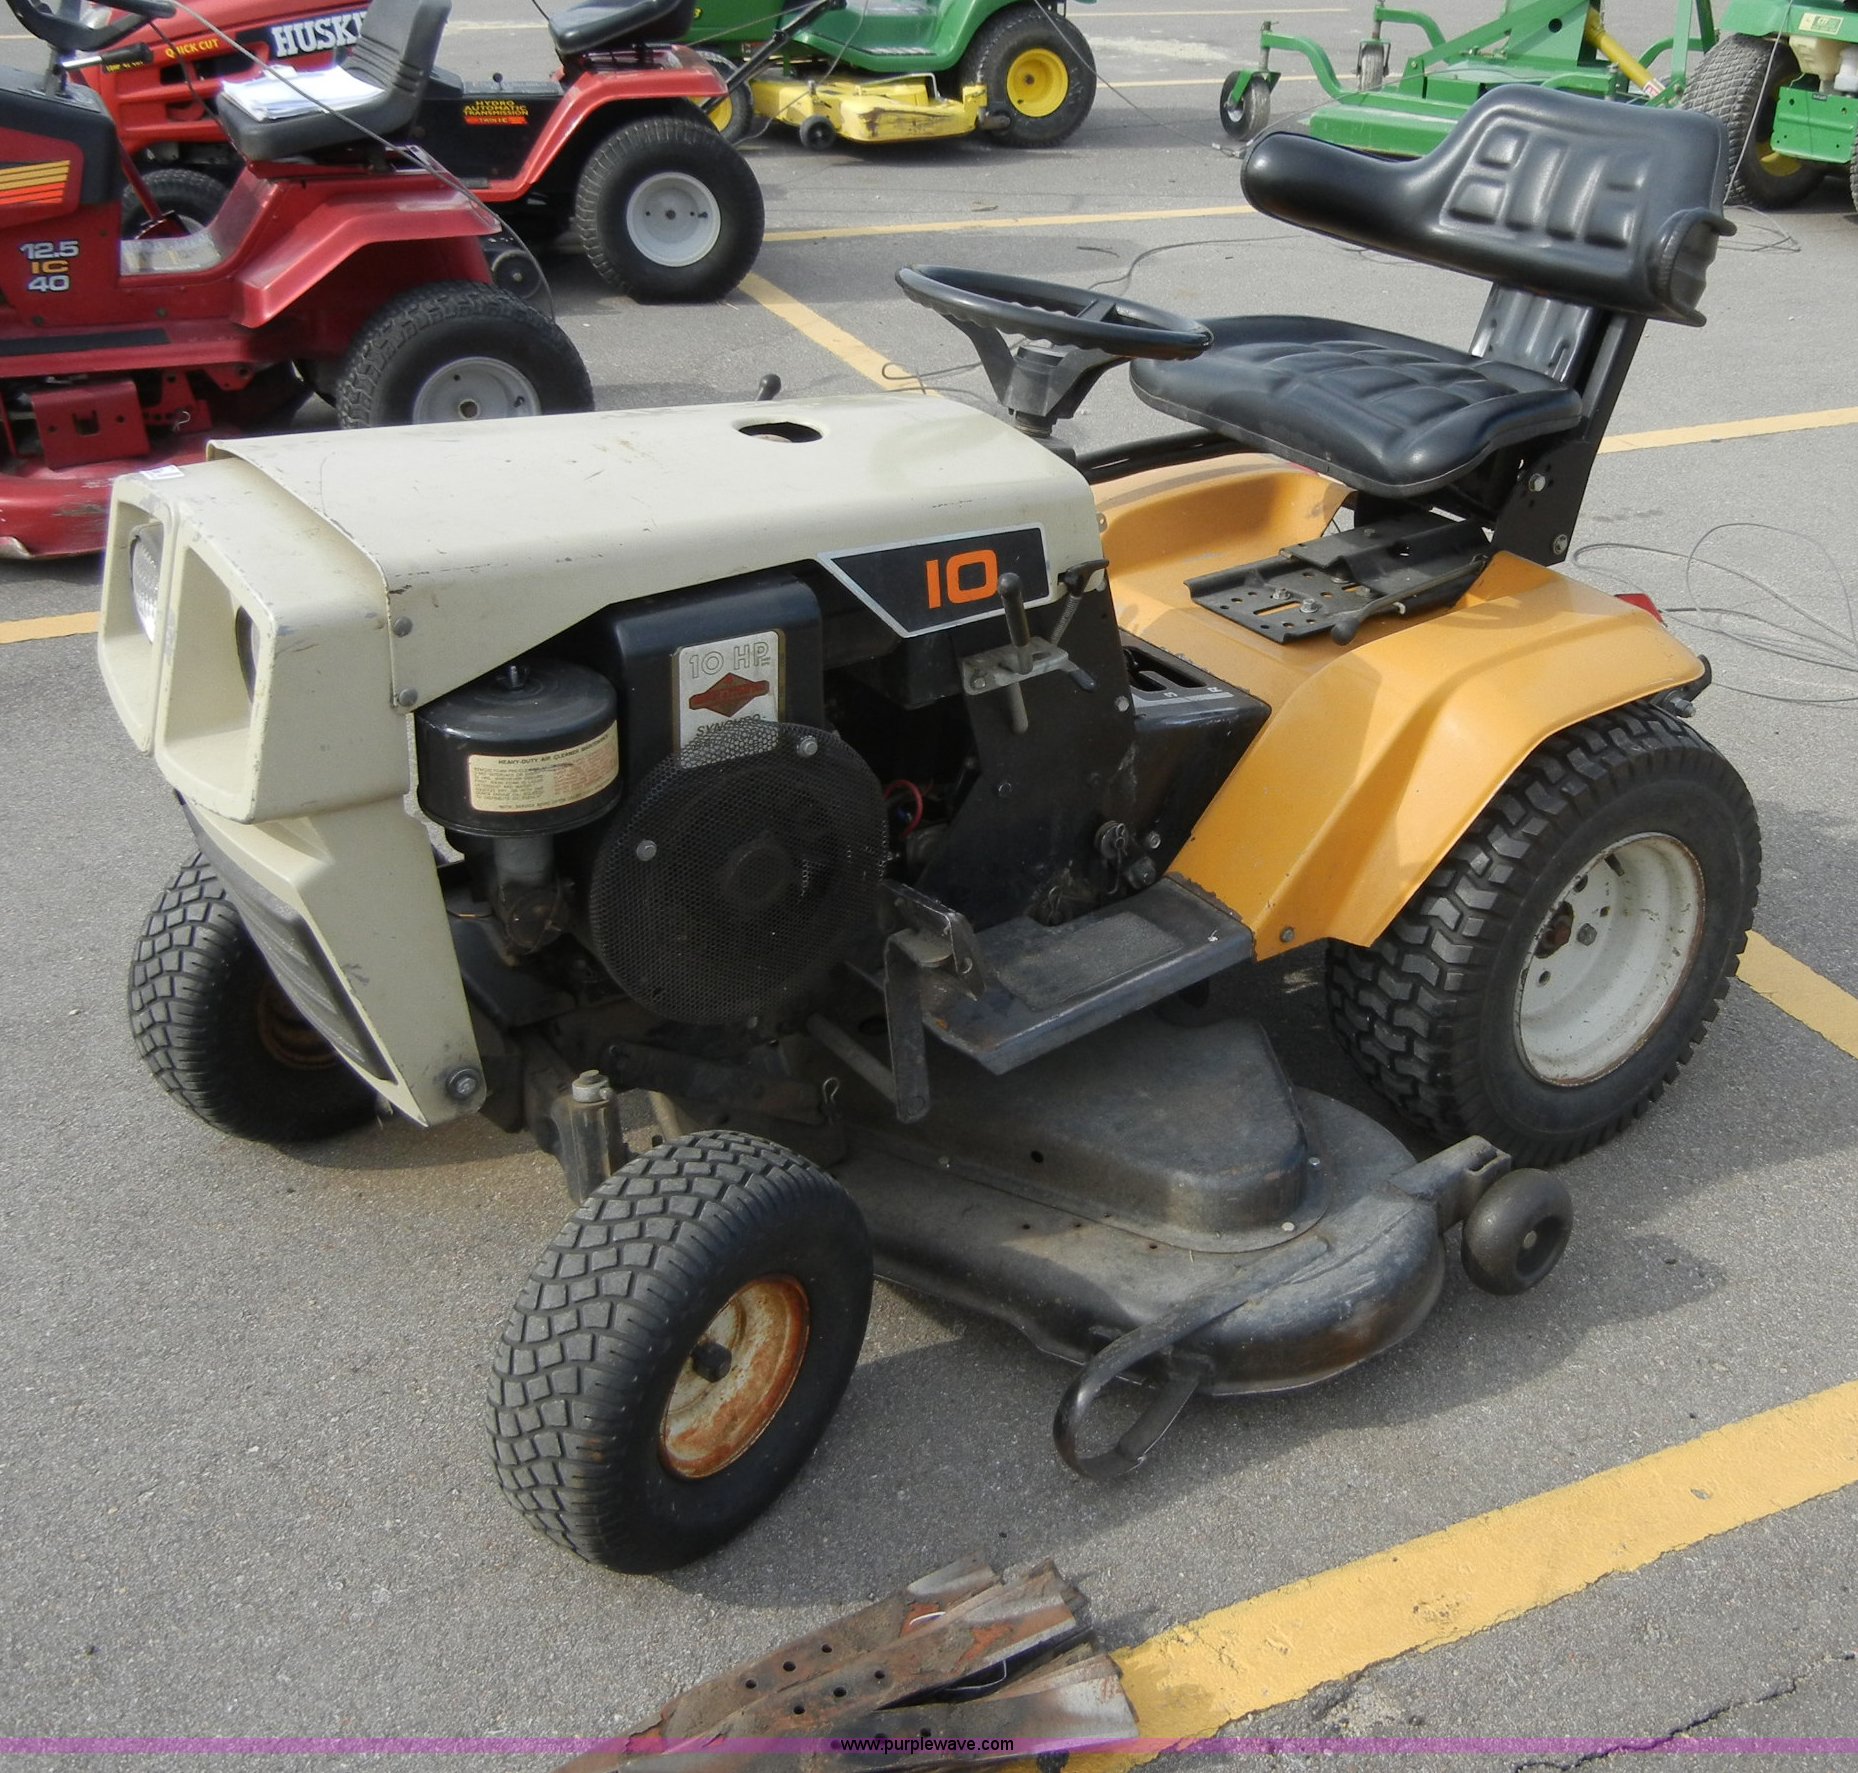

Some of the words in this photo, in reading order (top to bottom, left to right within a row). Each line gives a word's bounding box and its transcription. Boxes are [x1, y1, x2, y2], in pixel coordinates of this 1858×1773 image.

[199, 38, 219, 50] CUT
[19, 240, 80, 260] 12.5
[31, 260, 69, 274] IC
[27, 274, 70, 292] 40
[926, 549, 998, 609] 10
[689, 650, 724, 679] 10
